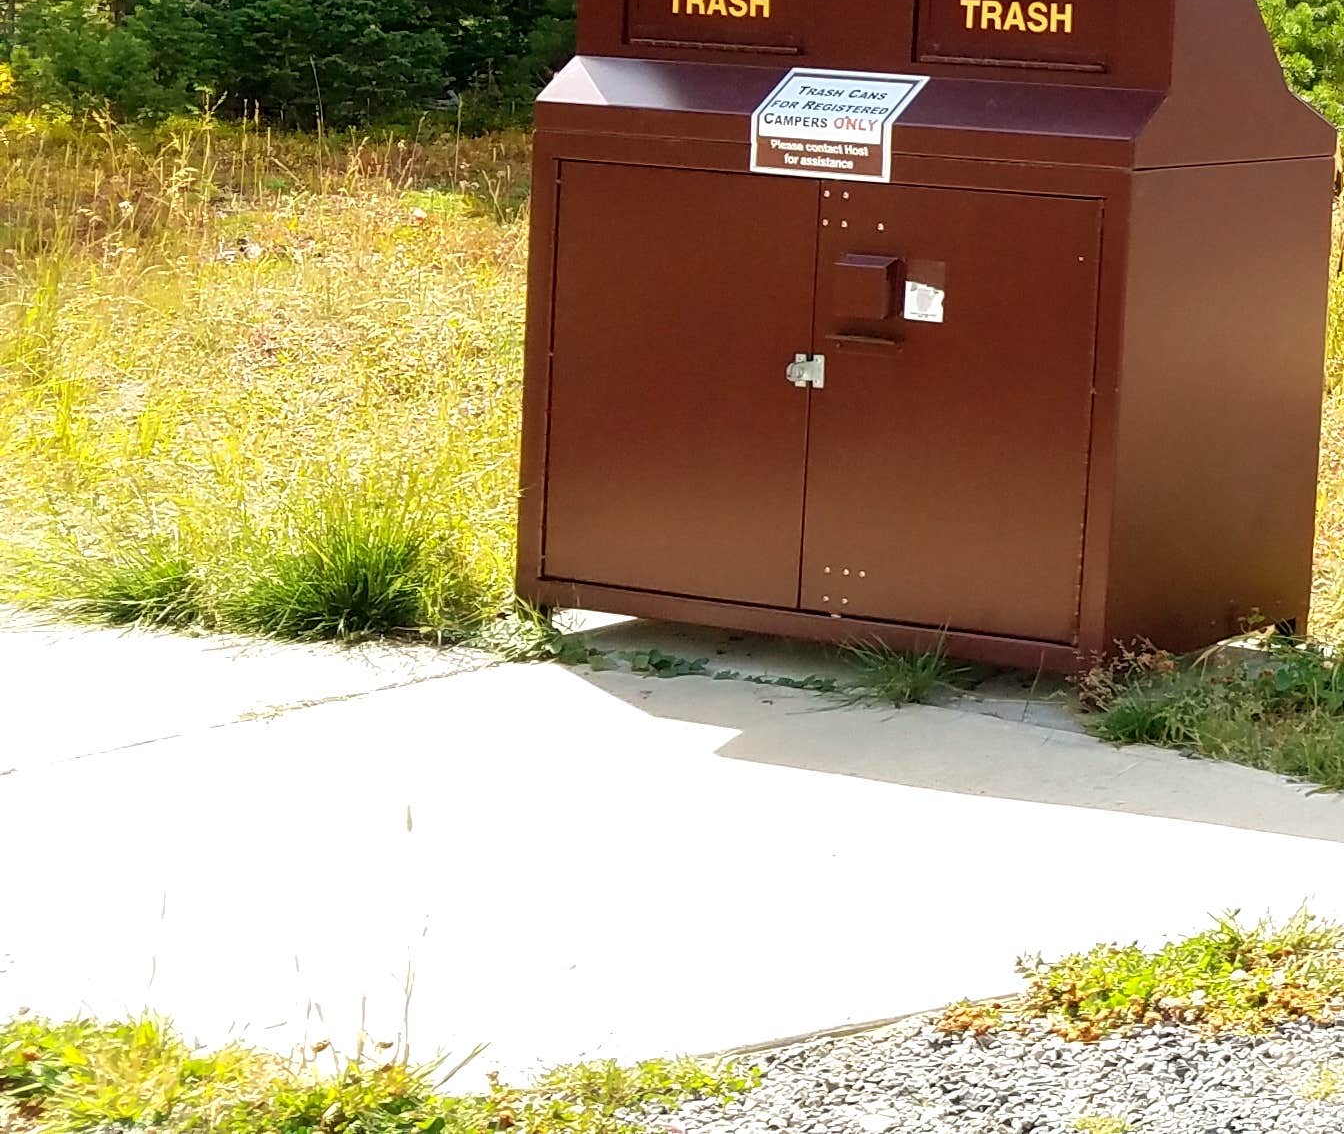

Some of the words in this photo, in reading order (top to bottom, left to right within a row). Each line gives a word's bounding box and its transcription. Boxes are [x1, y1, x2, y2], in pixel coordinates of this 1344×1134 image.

[960, 0, 1073, 33] TRASH
[798, 85, 845, 98] TRASH
[848, 88, 888, 100] CANS
[770, 99, 799, 110] FOR
[802, 100, 889, 115] REGISTERED
[763, 112, 828, 128] CAMPERS
[833, 116, 878, 132] ONLY
[770, 139, 804, 151] Please
[806, 143, 842, 155] contact
[844, 145, 869, 156] Host
[783, 153, 798, 164] for
[800, 155, 854, 170] assistance
